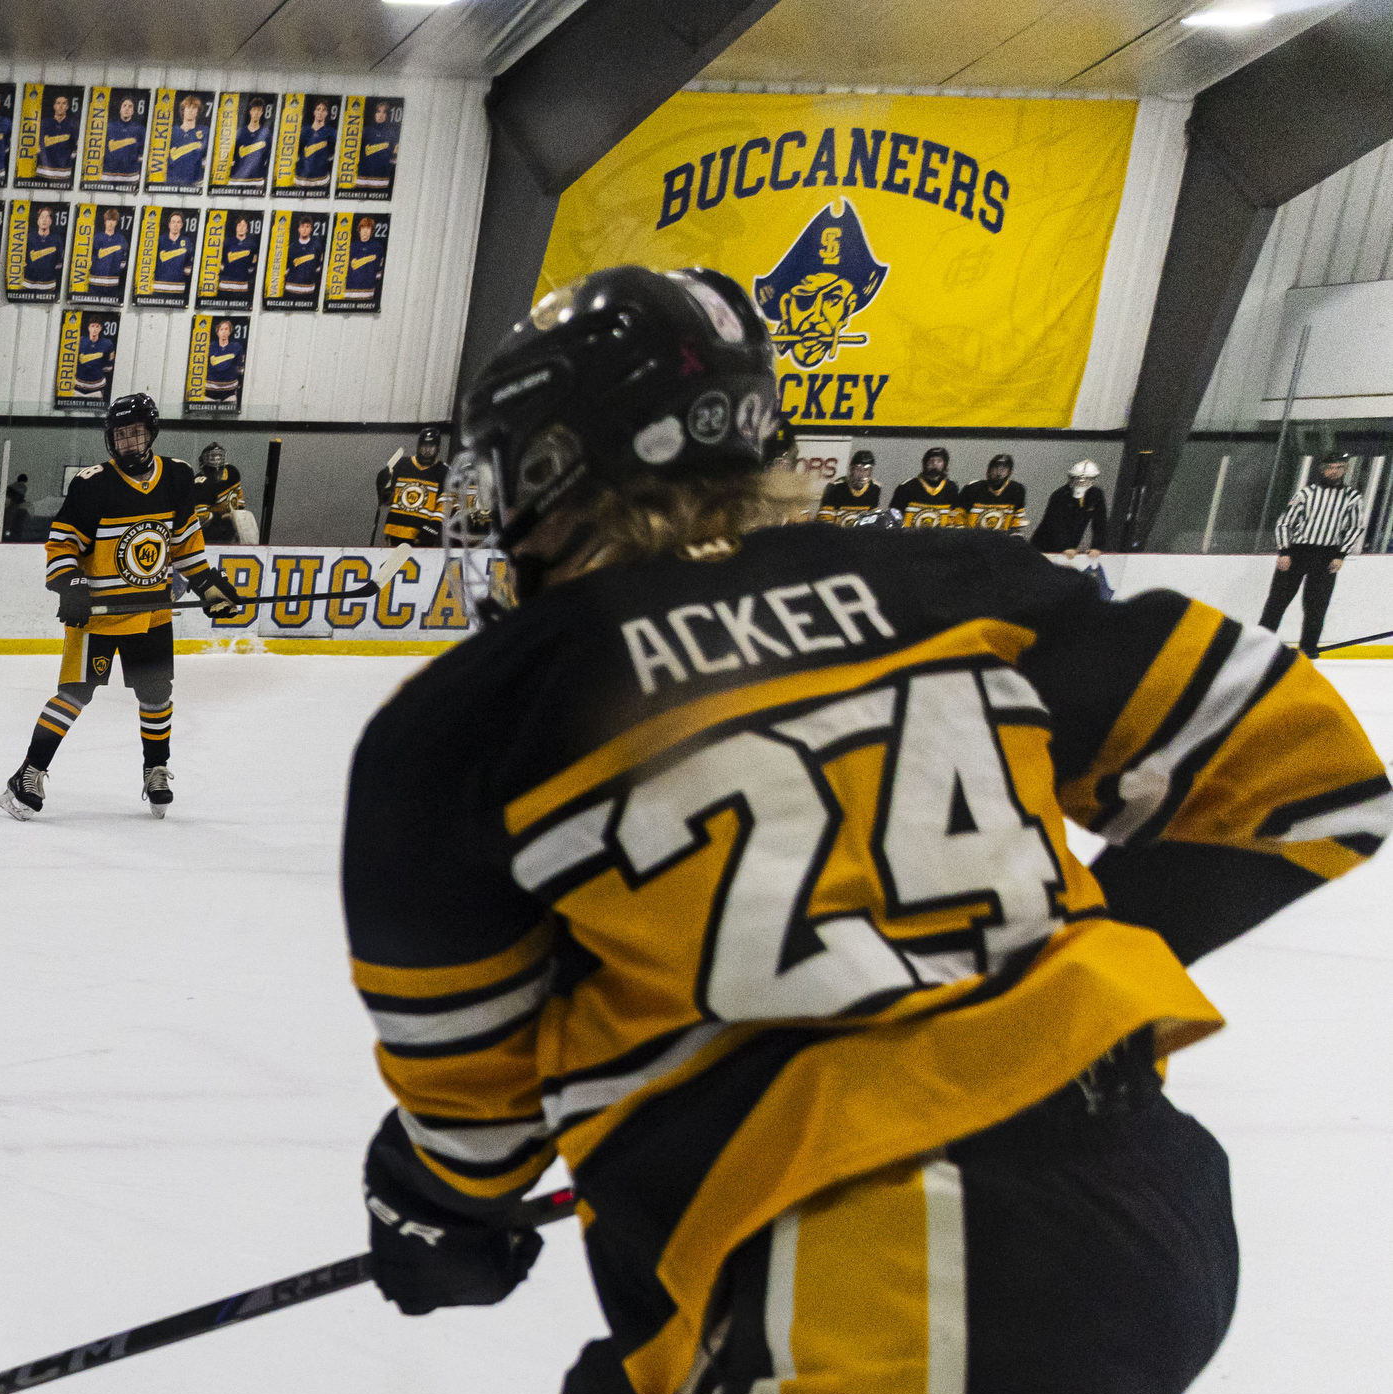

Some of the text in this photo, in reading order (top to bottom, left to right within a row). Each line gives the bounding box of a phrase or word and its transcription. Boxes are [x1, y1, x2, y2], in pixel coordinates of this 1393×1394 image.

[4, 94, 11, 109] 4
[71, 97, 79, 113] 5
[137, 99, 145, 115] 6
[205, 102, 213, 118] 7
[264, 104, 272, 119] 8
[330, 105, 337, 120] 9
[390, 107, 402, 123] 10
[19, 110, 39, 159] POEL
[85, 107, 105, 176] O'BRIEN
[151, 109, 171, 174] WILKIE
[215, 110, 233, 181] FRISINGER
[278, 113, 298, 179] TUGGLE
[341, 115, 360, 184] BRADEN
[655, 127, 1010, 235] BUCCANEERS
[55, 211, 67, 226] 15
[120, 216, 133, 230] 17
[185, 217, 197, 232] 18
[249, 220, 261, 234] 19
[313, 222, 326, 236] 21
[375, 223, 388, 237] 22
[9, 220, 26, 286] NOONAN
[73, 224, 92, 284] WELLS
[139, 222, 156, 292] ANDERSON
[202, 225, 222, 293] BUTLER
[331, 231, 349, 295] SPARKS
[103, 321, 117, 336] 30
[234, 324, 247, 339] 31
[59, 329, 78, 392] GRIBAR
[189, 331, 207, 398] ROGERS
[779, 373, 889, 421] CKEY
[118, 522, 152, 558] KENOWA
[620, 573, 898, 695] ACKER
[613, 666, 1065, 1023] 24
